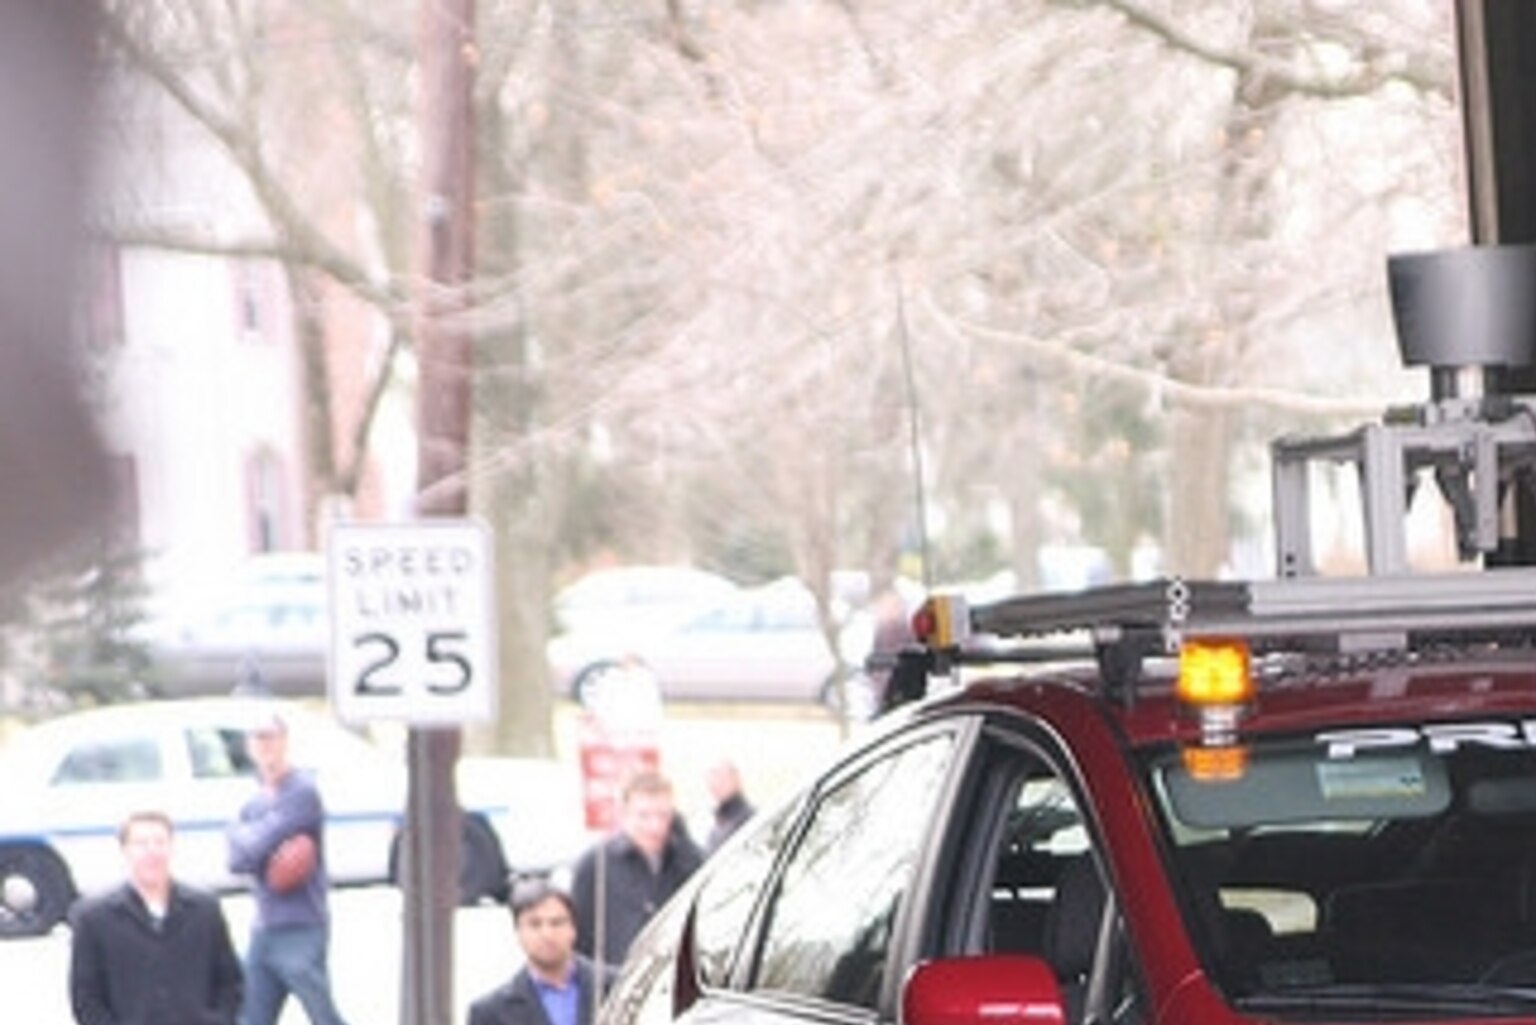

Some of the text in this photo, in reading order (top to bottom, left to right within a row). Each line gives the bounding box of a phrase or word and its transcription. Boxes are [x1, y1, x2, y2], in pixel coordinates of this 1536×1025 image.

[345, 547, 472, 576] SPEED
[355, 585, 460, 616] LIMIT
[353, 631, 472, 696] 25
